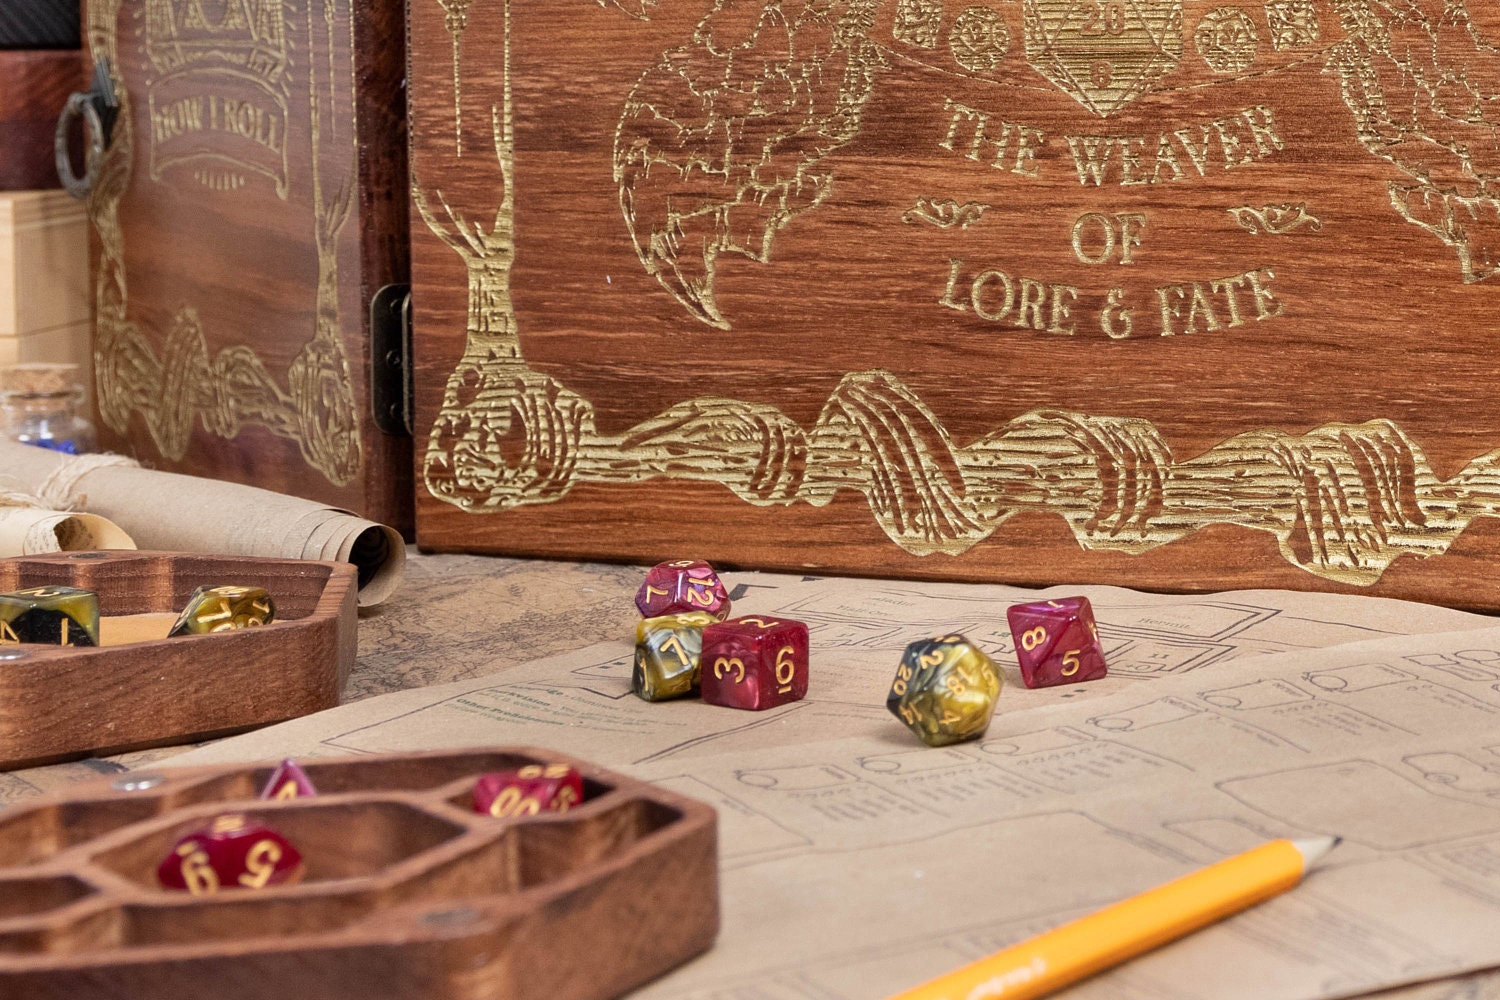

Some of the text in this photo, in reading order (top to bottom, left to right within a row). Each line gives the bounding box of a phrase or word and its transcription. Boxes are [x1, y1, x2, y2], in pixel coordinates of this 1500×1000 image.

[1079, 0, 1125, 37] 20
[153, 96, 201, 144] HOW
[225, 101, 281, 153] ROLL
[938, 98, 1286, 187] THE WEAVER
[1071, 211, 1147, 265] OF
[938, 257, 1284, 339] LORE & FATE
[686, 577, 716, 606] 12
[660, 636, 689, 666] 7
[1021, 626, 1046, 651] 8
[713, 657, 745, 684] 3
[1060, 649, 1081, 676] 5
[893, 664, 912, 696] 20
